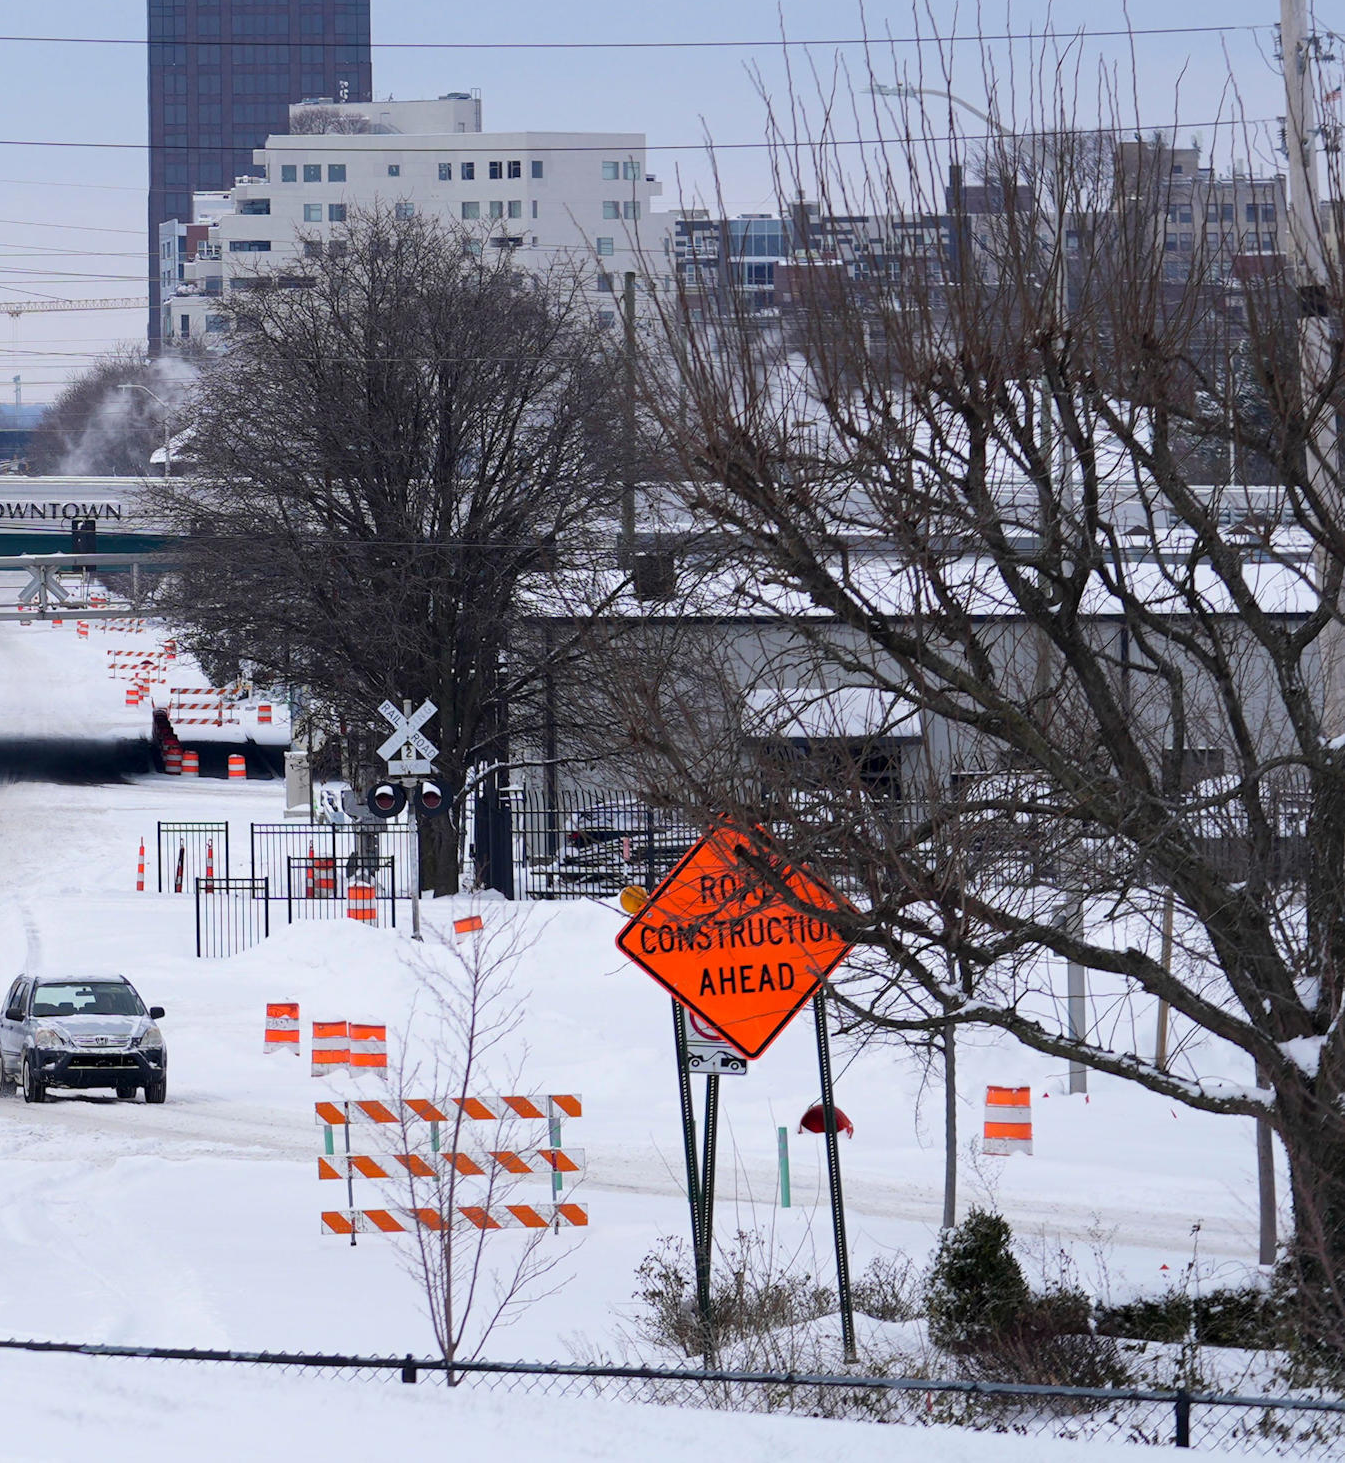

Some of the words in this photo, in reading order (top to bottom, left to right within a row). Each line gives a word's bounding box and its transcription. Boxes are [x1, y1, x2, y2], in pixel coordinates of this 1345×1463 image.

[381, 703, 401, 726] RAIL
[411, 733, 436, 759] ROAD
[699, 962, 795, 997] AHEAD
